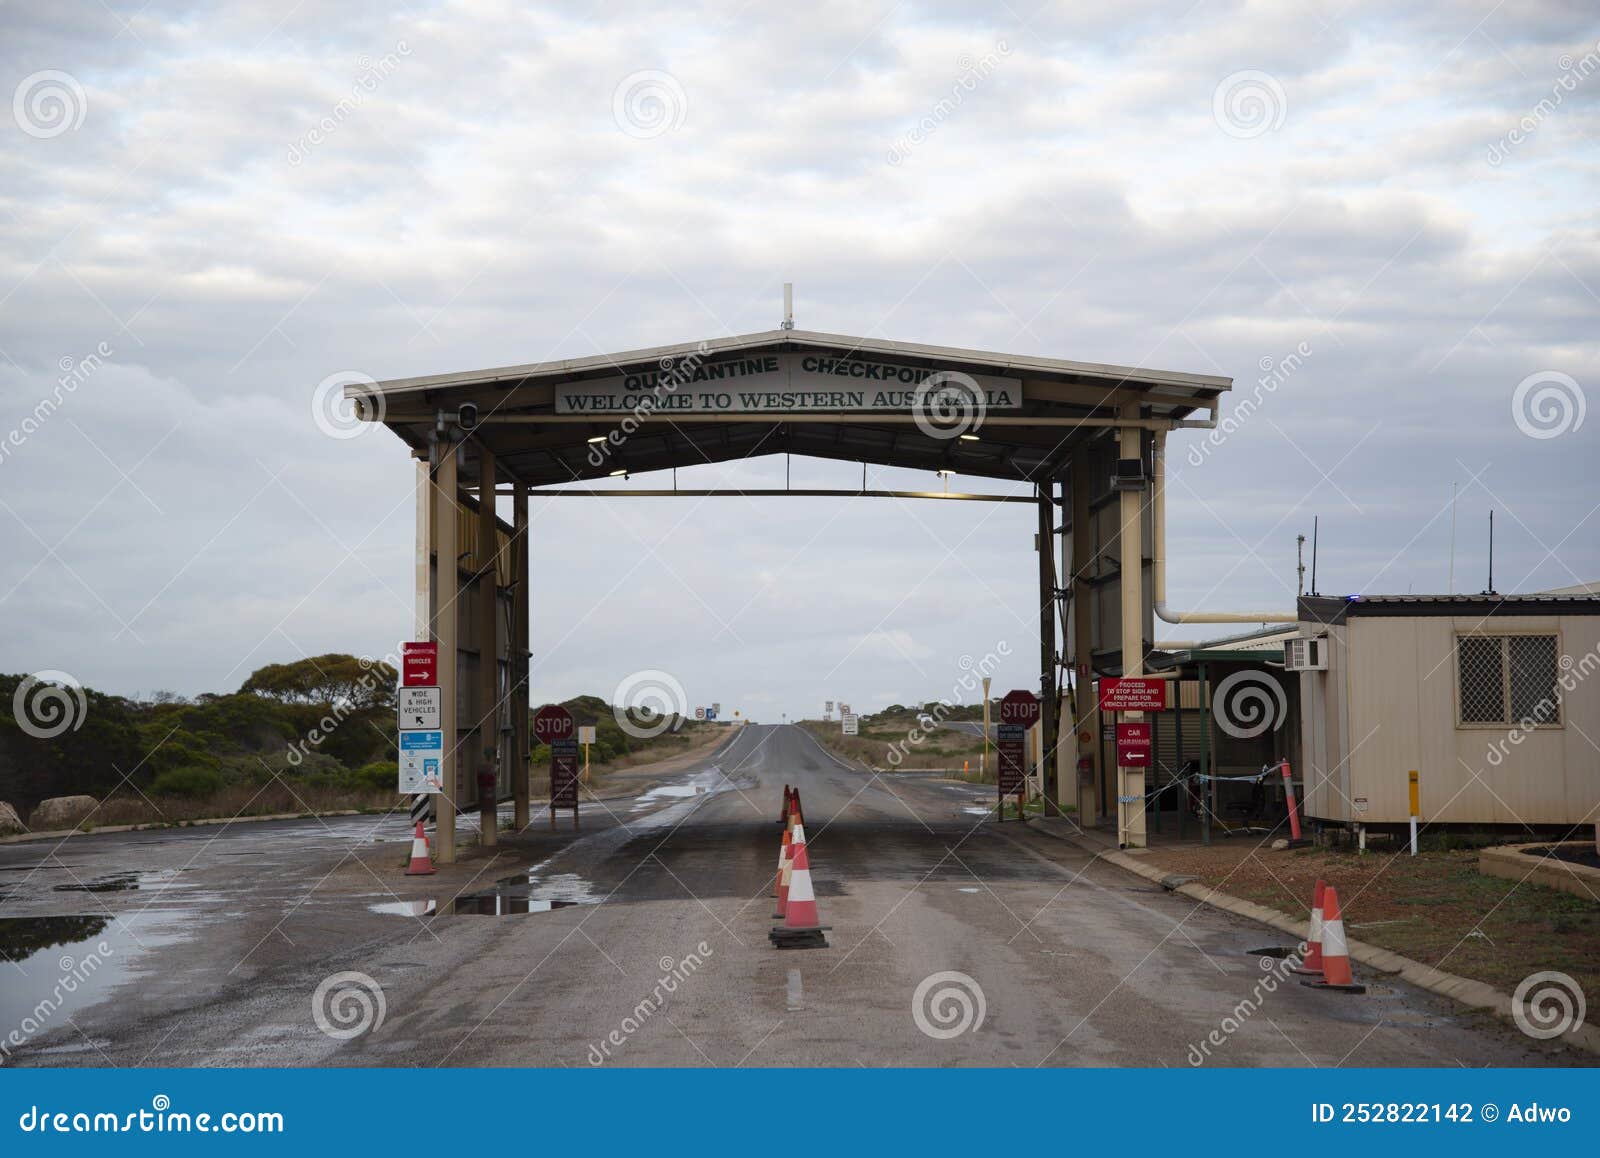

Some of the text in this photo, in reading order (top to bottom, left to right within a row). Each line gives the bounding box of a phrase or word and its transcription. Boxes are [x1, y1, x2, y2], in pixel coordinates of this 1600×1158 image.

[624, 356, 953, 391] QUARANTINE CHECKPOINT
[564, 390, 1013, 410] WELCOME TO WESTERN AUSTRALIA
[1003, 703, 1038, 718] STOP
[536, 718, 572, 733] STOP
